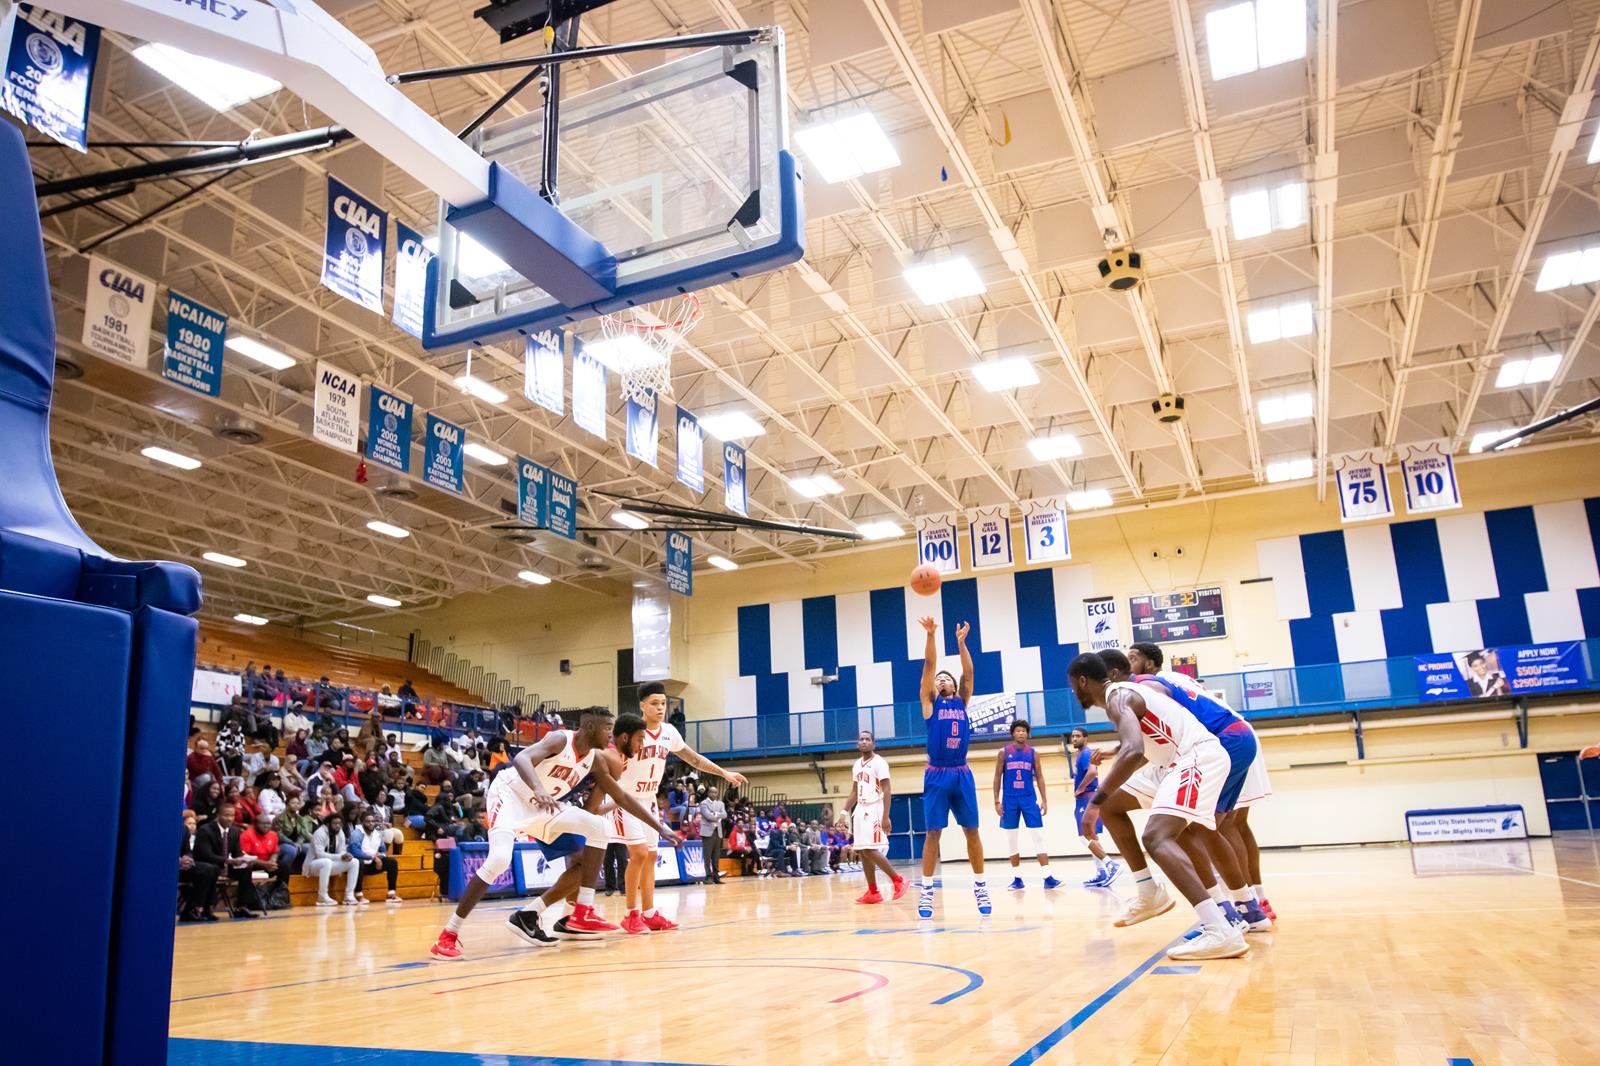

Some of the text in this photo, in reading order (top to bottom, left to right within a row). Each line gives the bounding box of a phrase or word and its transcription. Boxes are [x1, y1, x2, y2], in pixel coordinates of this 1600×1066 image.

[334, 195, 381, 240] CIAA
[402, 239, 431, 264] CIA
[99, 268, 145, 303] CIAA
[104, 315, 128, 335] 1981
[169, 299, 225, 335] NCAIAW
[179, 328, 211, 352] 1980
[167, 348, 215, 375] BASKETBALL
[166, 368, 211, 393] CHAMPIONS
[321, 370, 357, 399] NCAA
[328, 391, 347, 407] 1978
[378, 394, 406, 420] CIAA
[320, 410, 351, 428] ATLANTIC
[325, 403, 348, 418] SOUTH
[315, 425, 353, 446] CHAMPIONS
[380, 428, 398, 444] 2002
[433, 422, 459, 446] CIAA
[372, 451, 403, 469] CHAMPIONS
[435, 453, 452, 468] 2003
[725, 446, 743, 470] CIAA
[1407, 462, 1446, 473] TROTMAN
[522, 463, 544, 485] CIAA
[552, 475, 573, 495] NAIA
[1350, 472, 1371, 480] PUGH
[1414, 471, 1444, 496] 10
[1348, 480, 1378, 505] 75
[670, 532, 689, 554] CIAA
[925, 532, 950, 541] TRAHAN
[981, 533, 1002, 556] 12
[1040, 525, 1055, 547] 3
[924, 540, 953, 563] 00
[1087, 602, 1115, 617] ECSU
[1091, 639, 1120, 650] VIKINGS
[951, 721, 959, 736] 0
[649, 764, 655, 779] 1
[636, 781, 658, 792] STATE
